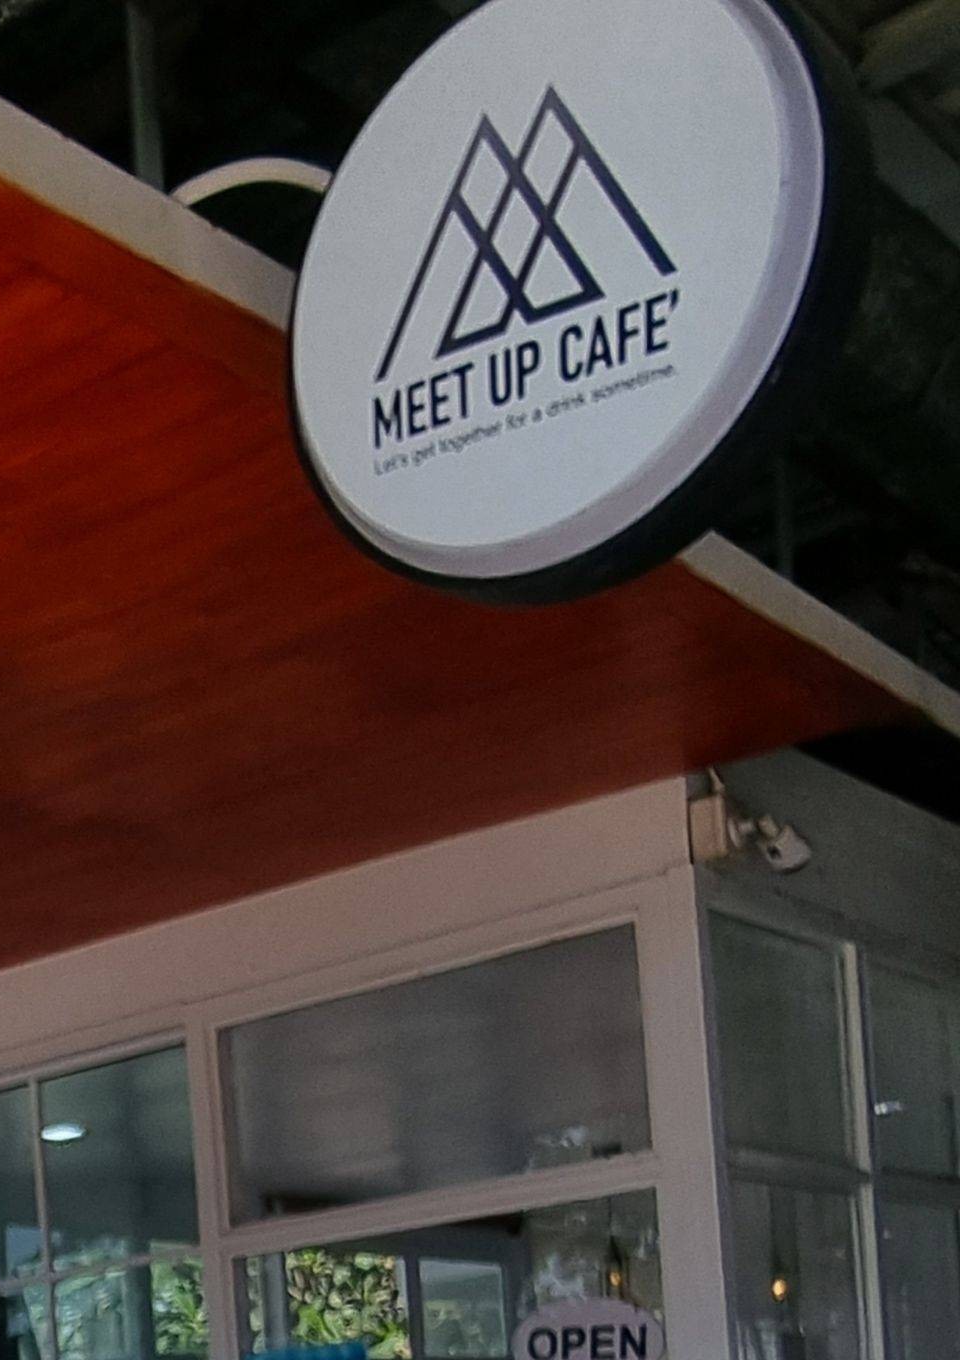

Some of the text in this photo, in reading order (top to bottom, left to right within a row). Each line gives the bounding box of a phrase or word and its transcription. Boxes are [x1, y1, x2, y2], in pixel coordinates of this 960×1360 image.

[373, 288, 679, 449] MEET UP CAFE'
[438, 420, 503, 453] together
[505, 412, 528, 430] for
[531, 407, 542, 423] a
[545, 393, 585, 417] drink
